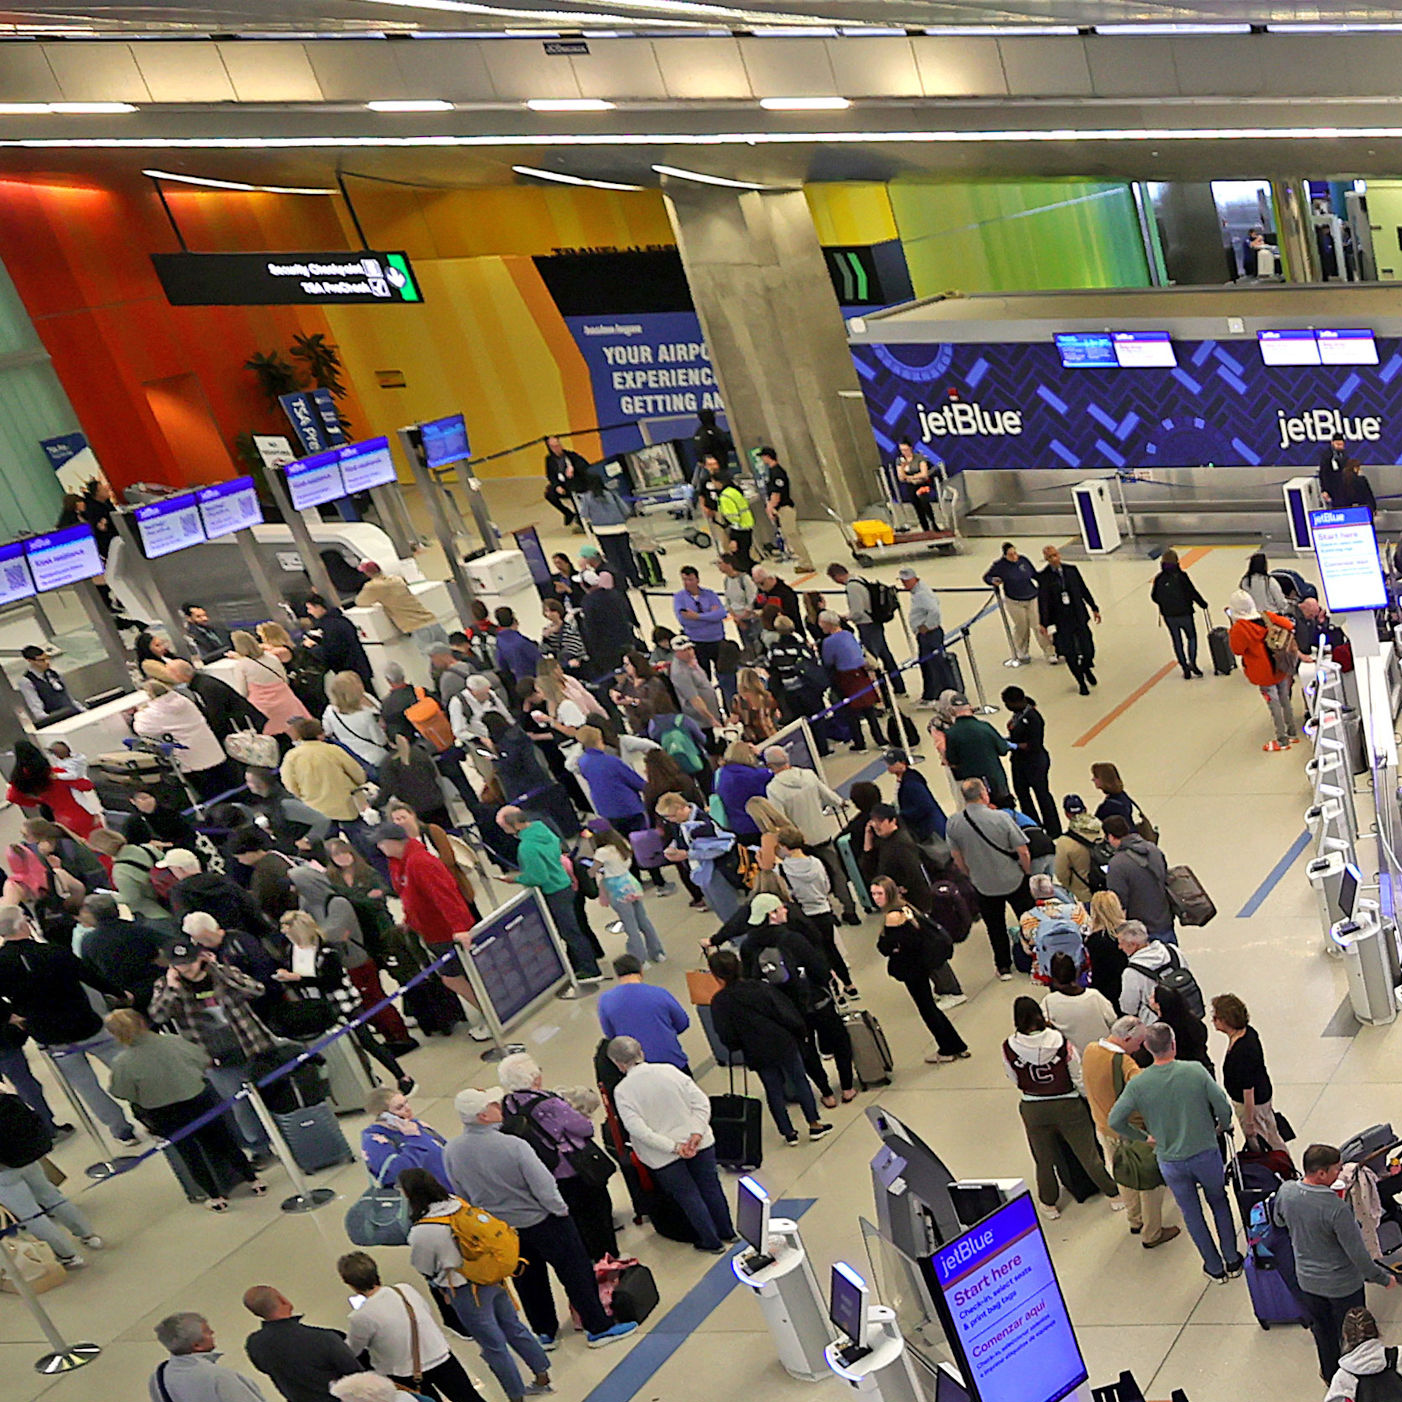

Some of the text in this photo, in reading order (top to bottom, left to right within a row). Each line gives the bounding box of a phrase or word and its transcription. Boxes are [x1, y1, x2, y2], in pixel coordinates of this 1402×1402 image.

[602, 345, 654, 365] YOUR
[620, 392, 698, 414] GETTING
[916, 402, 1020, 443] jetBlue
[1277, 409, 1381, 449] jetBlue
[939, 1228, 993, 1278] jetBlue
[953, 1253, 1022, 1307] Start here
[968, 1309, 987, 1328] print
[986, 1299, 1001, 1314] bag
[1000, 1289, 1017, 1304] tags
[971, 1315, 1024, 1358] Comenzar
